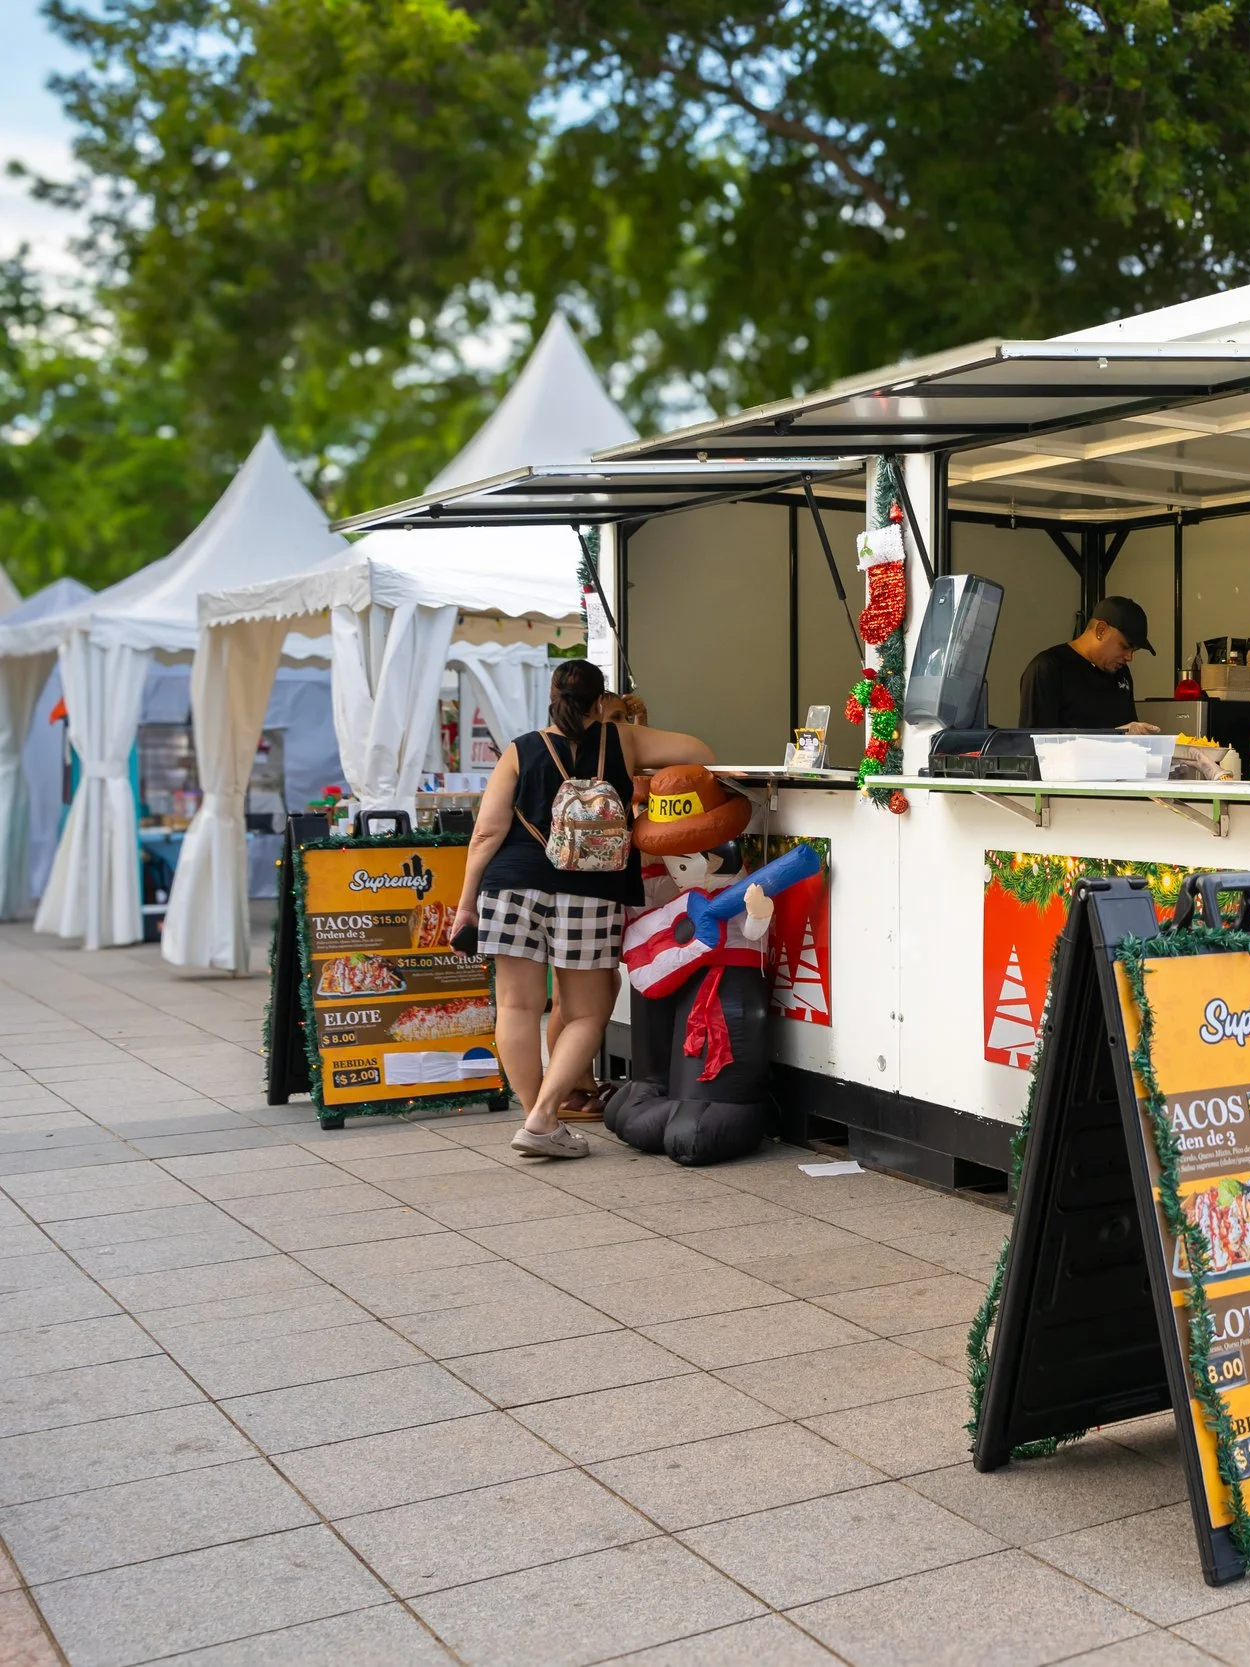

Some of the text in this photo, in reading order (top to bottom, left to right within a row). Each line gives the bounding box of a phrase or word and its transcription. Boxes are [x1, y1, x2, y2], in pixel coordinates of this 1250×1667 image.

[660, 799, 692, 816] RICO
[349, 870, 428, 892] Supremos
[312, 915, 407, 930] TACOS $15.00
[316, 930, 366, 940] Orden de 3
[397, 958, 433, 968] $15.00
[434, 954, 483, 966] NACHOS
[323, 1009, 382, 1027] ELOTE
[332, 1057, 378, 1069] BEBIDAS
[1161, 1095, 1245, 1133] ACOS
[1176, 1129, 1236, 1151] den de 3
